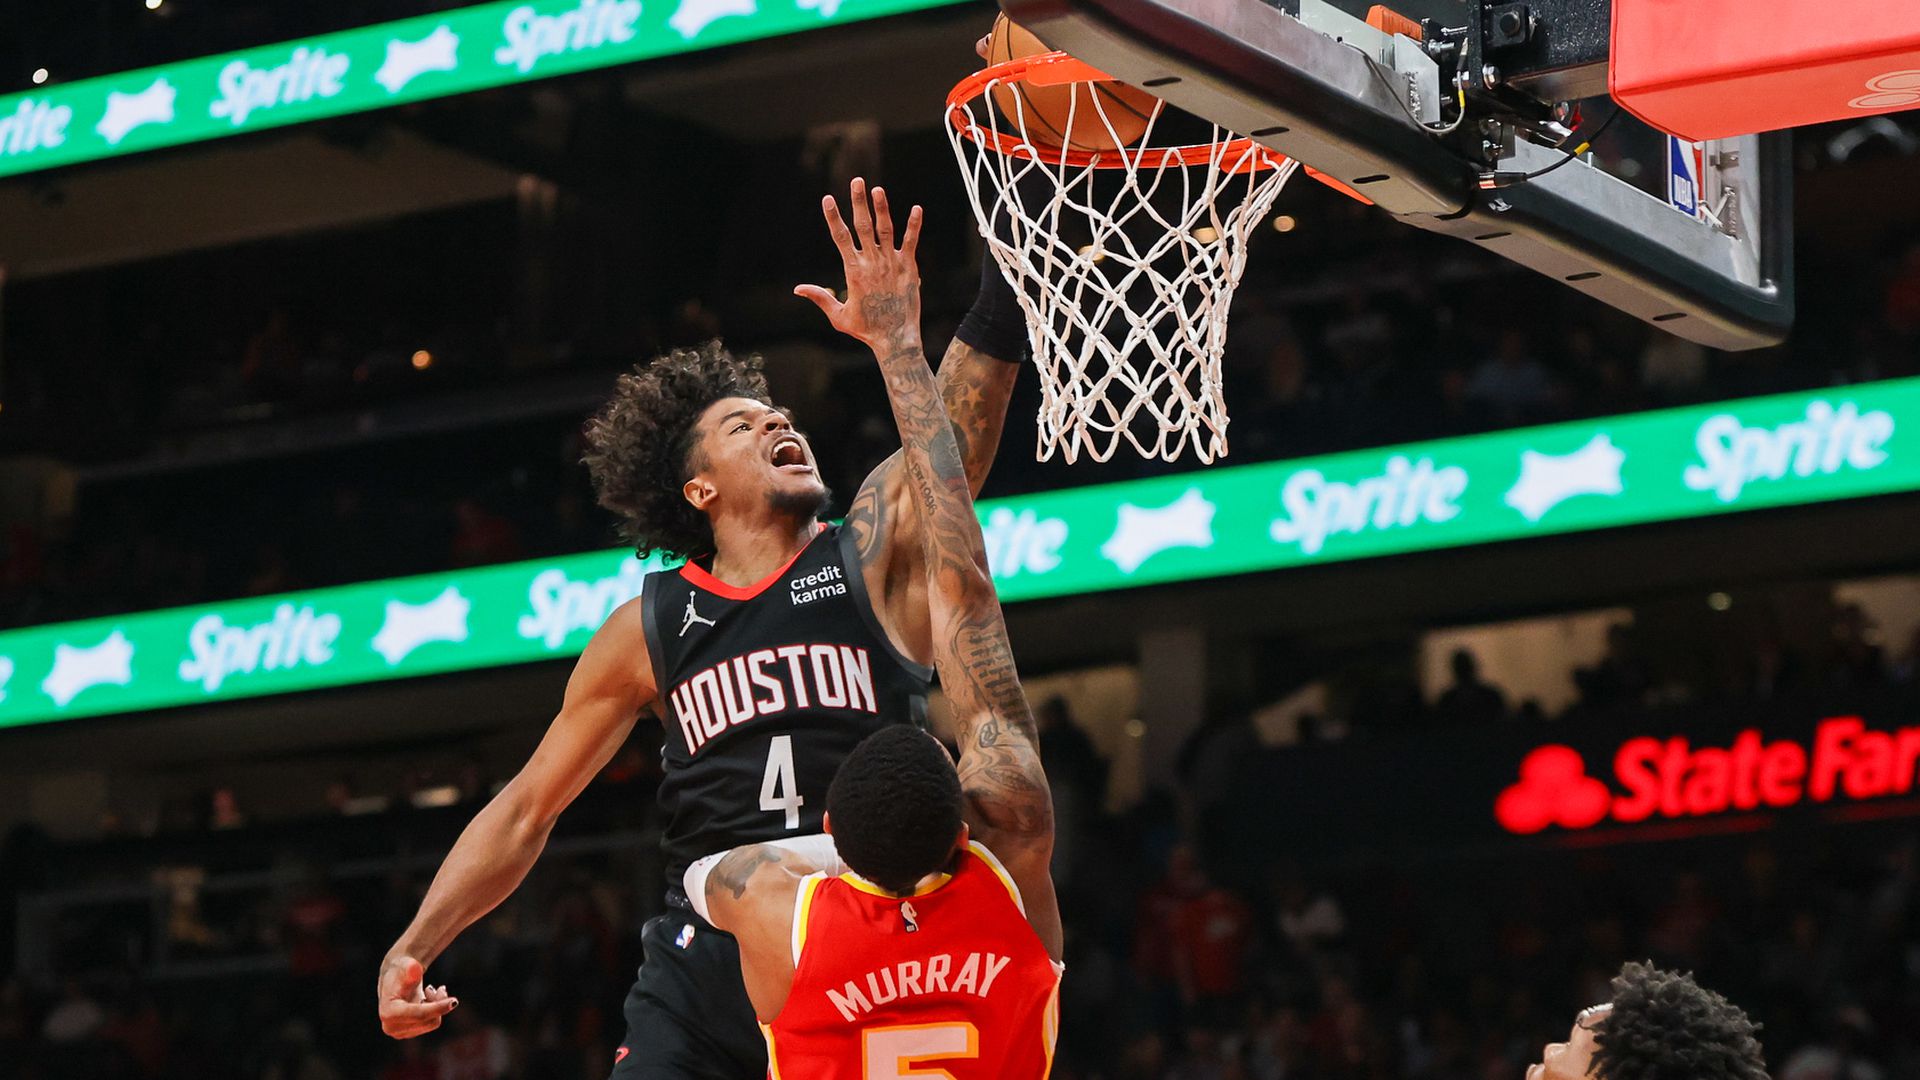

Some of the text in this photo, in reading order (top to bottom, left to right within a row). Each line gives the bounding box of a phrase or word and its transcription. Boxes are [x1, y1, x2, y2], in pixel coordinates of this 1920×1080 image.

[494, 0, 642, 73] Sprite
[210, 47, 350, 125] Sprite
[1684, 401, 1894, 502] Sprite
[1270, 455, 1468, 555] Sprite
[790, 565, 842, 590] credit
[790, 582, 847, 606] karma
[179, 603, 341, 692] Sprite
[670, 643, 878, 756] HOUSTON
[758, 734, 804, 830] 4
[1611, 716, 1920, 813] State Far
[825, 952, 1011, 1023] MURRAY
